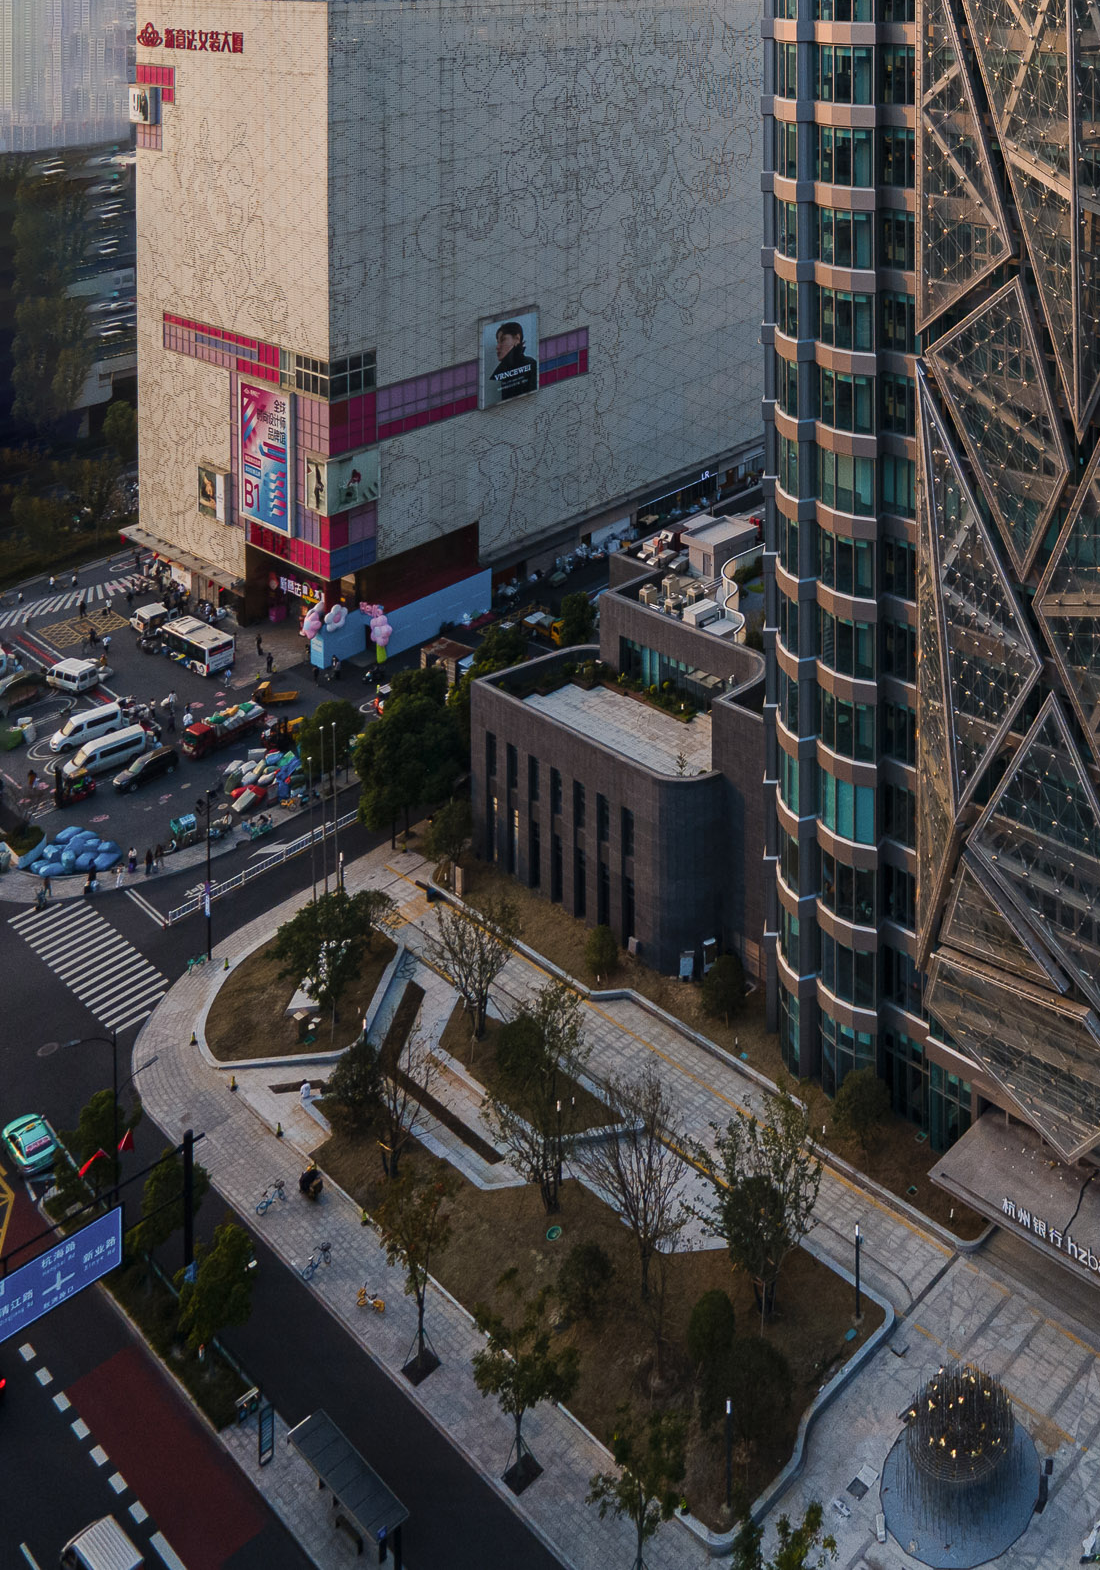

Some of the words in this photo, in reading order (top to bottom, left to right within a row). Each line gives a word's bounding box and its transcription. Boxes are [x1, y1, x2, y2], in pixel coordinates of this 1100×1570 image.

[164, 28, 244, 53] 新意法女装大厦
[244, 478, 260, 512] B1
[1002, 1197, 1063, 1248] 杭州银行
